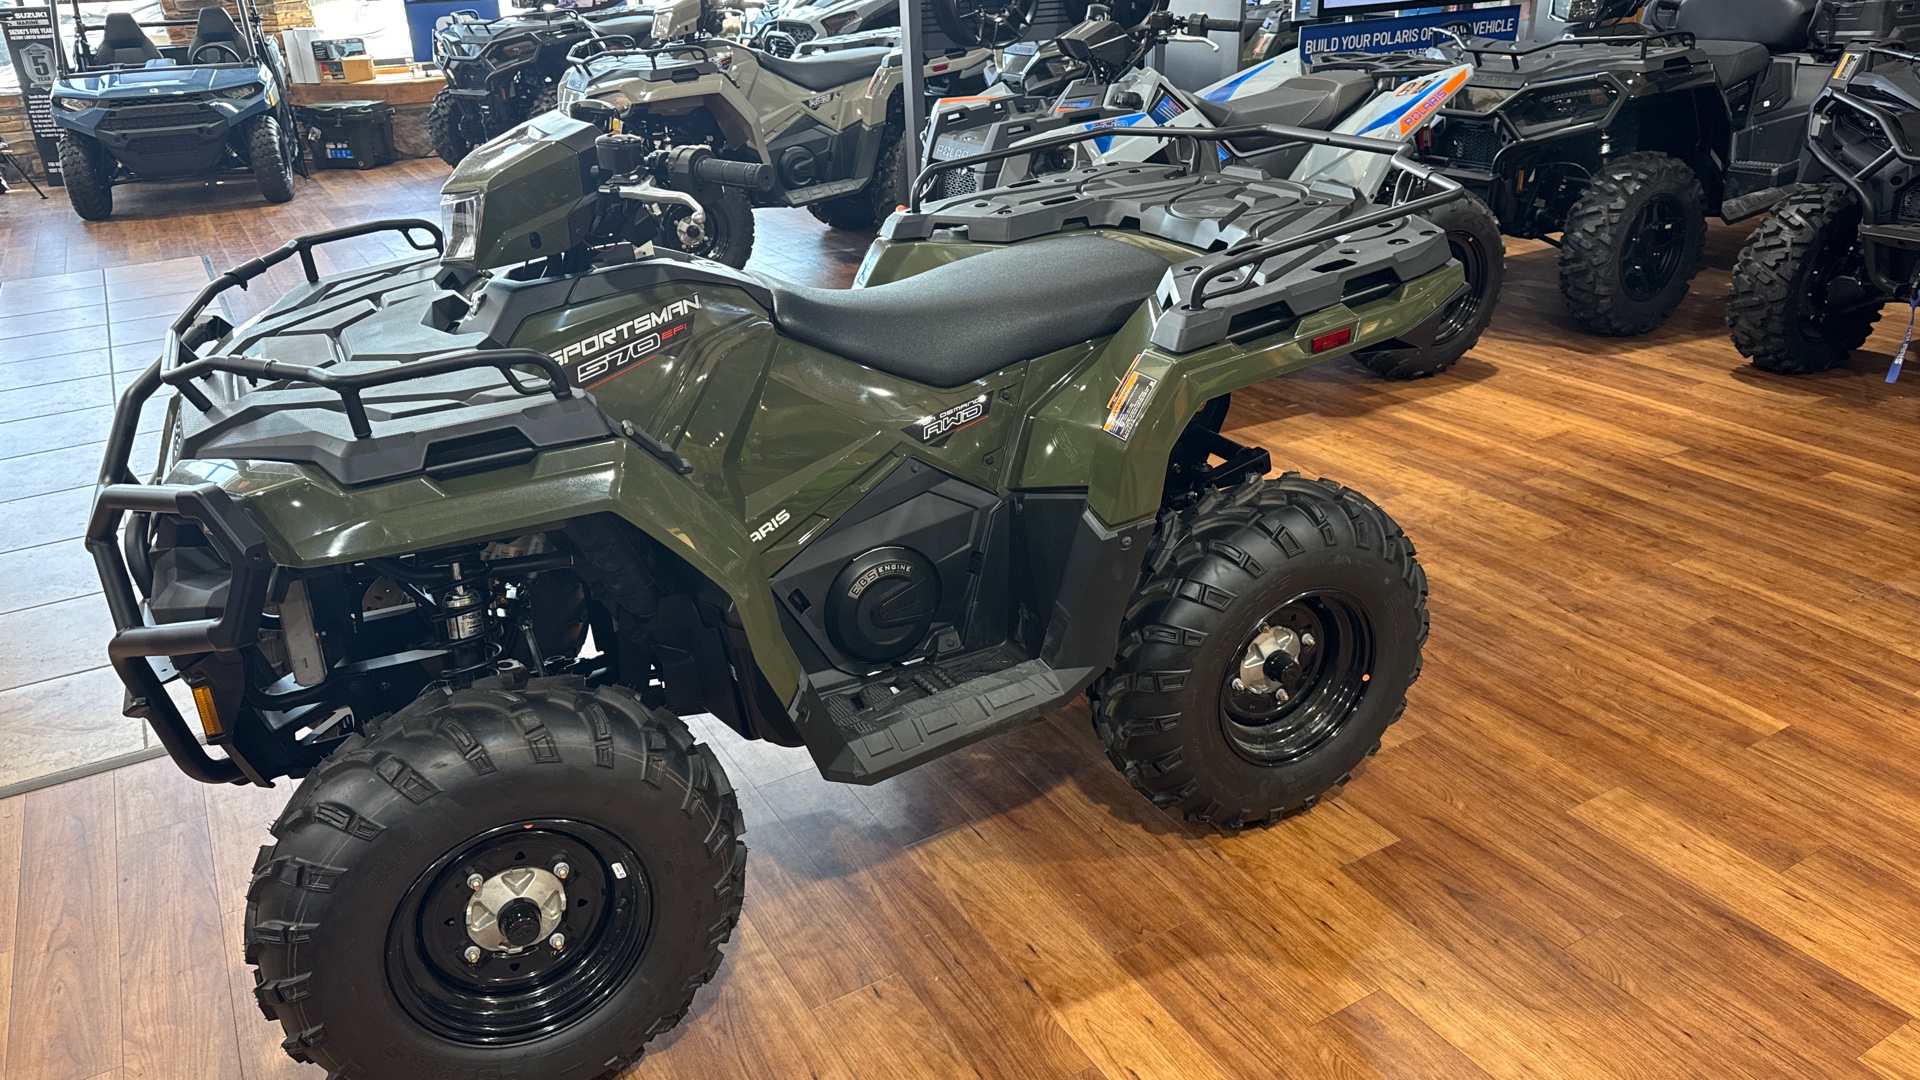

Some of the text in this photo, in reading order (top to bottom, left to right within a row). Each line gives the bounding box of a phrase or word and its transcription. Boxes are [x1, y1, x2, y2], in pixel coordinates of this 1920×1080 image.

[1305, 37, 1339, 55] BUILD
[1341, 34, 1371, 51] YOUR
[1372, 30, 1419, 47] POLARIS
[1472, 17, 1515, 36] VEHICLE
[32, 55, 50, 76] 5
[1404, 89, 1448, 127] POLARIS
[548, 292, 702, 367] SPORTSMAN
[577, 323, 688, 383] 570 EFI
[923, 403, 983, 440] AWD
[850, 564, 912, 596] EBS ENGINE
